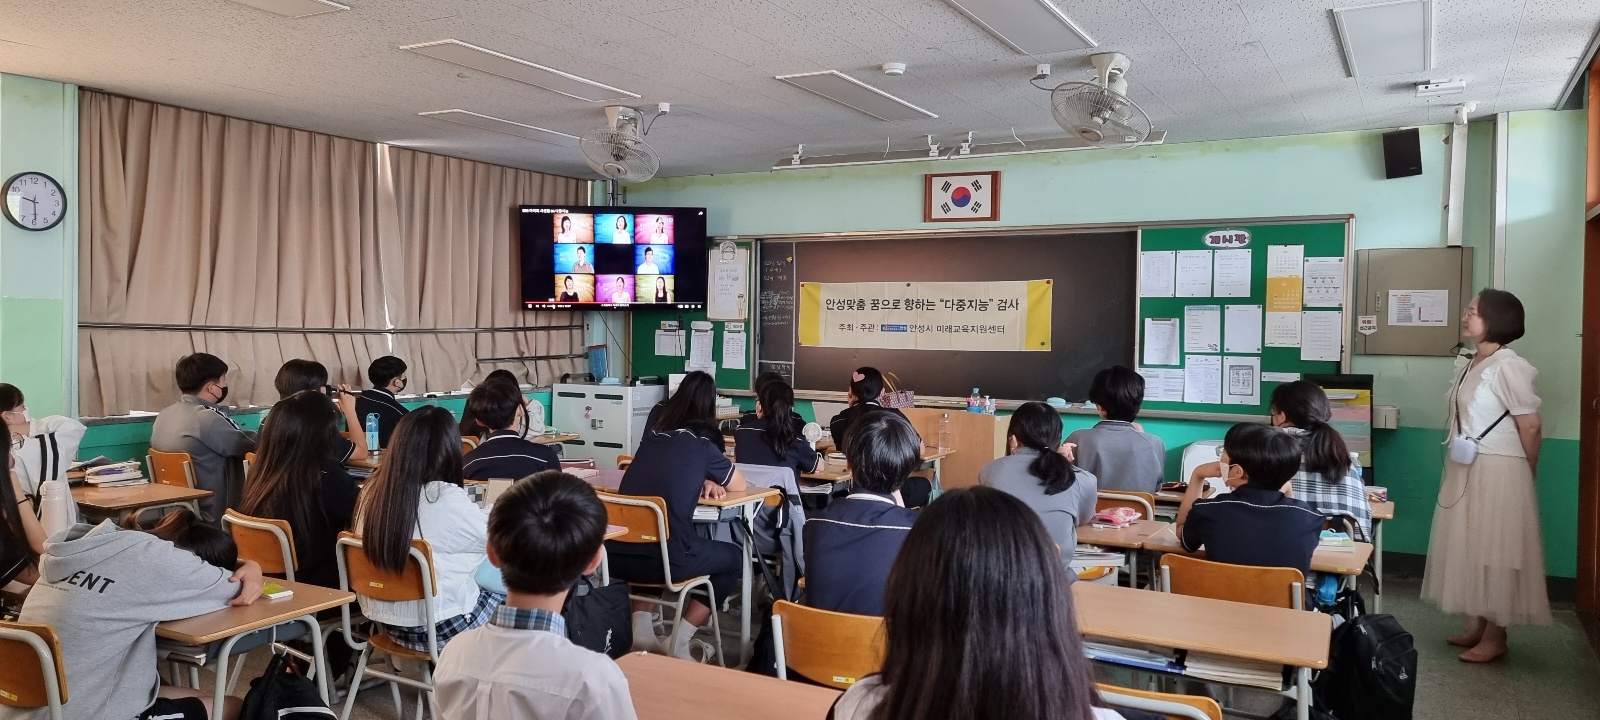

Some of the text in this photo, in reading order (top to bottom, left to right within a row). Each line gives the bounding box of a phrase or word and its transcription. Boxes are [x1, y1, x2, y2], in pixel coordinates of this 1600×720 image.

[825, 298, 867, 311] 안성맞춤
[870, 298, 902, 311] 꿈으로
[904, 298, 936, 311] 향하는
[996, 298, 1020, 311] 검사
[909, 324, 934, 334] 안성시
[936, 324, 1005, 334] 미래교육지원센터
[60, 570, 115, 593] ENT
